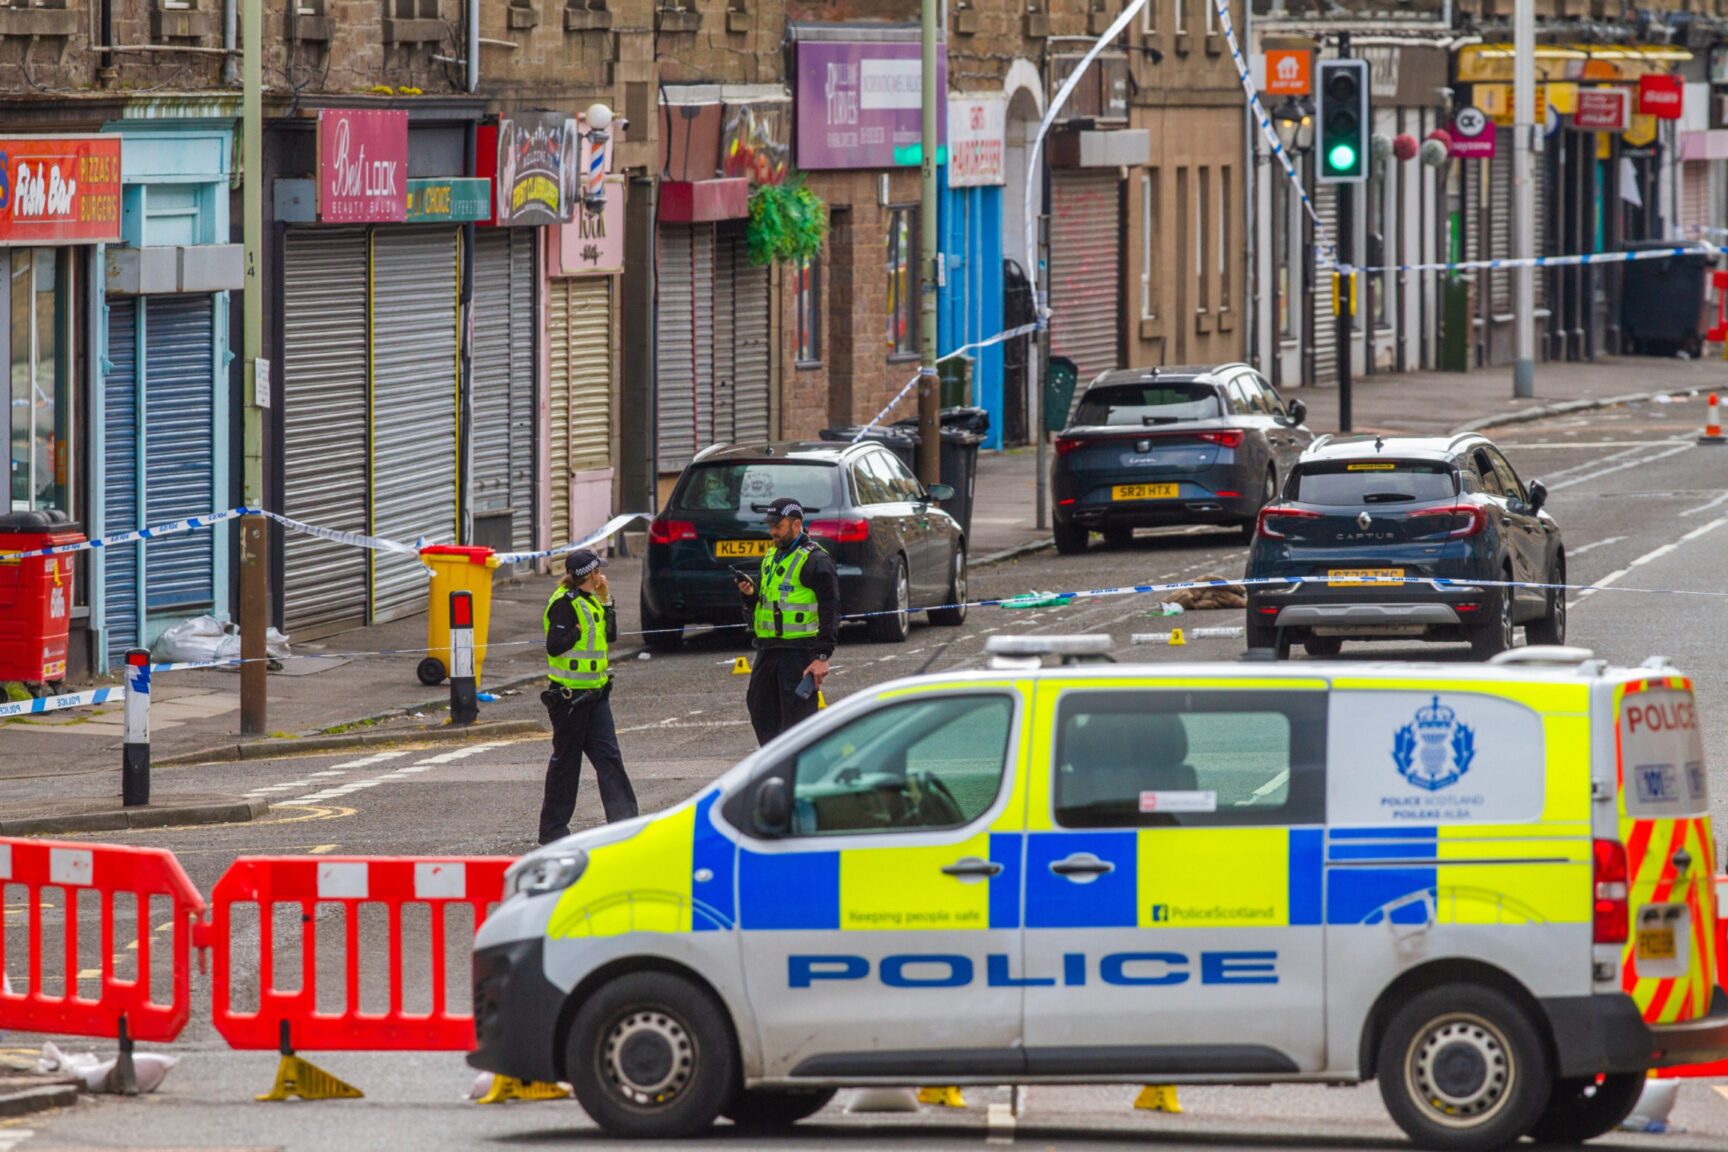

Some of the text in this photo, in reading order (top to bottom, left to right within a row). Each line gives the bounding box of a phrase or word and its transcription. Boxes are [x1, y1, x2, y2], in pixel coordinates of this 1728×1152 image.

[1271, 79, 1304, 88] JUST EAT
[332, 118, 397, 197] Best LOOK
[80, 156, 110, 184] PIZZAS
[14, 161, 46, 217] Fish
[47, 163, 76, 216] Bar
[332, 201, 364, 214] BEAUTY
[370, 200, 396, 214] SALON
[424, 186, 451, 214] CHOICE
[80, 194, 117, 222] BURGERS
[1120, 484, 1172, 498] SR21 HTX
[1335, 532, 1395, 541] CAPTUR
[720, 542, 754, 554] KL57
[1173, 631, 1180, 640] 3
[737, 660, 743, 668] 4
[1625, 702, 1698, 735] POLICE
[1380, 795, 1485, 806] POLICE SCOTLAND
[1443, 809, 1472, 819] ALBA
[849, 908, 981, 924] Keeping people safe
[1172, 905, 1275, 918] PoliceScotland
[787, 951, 1279, 988] POLICE
